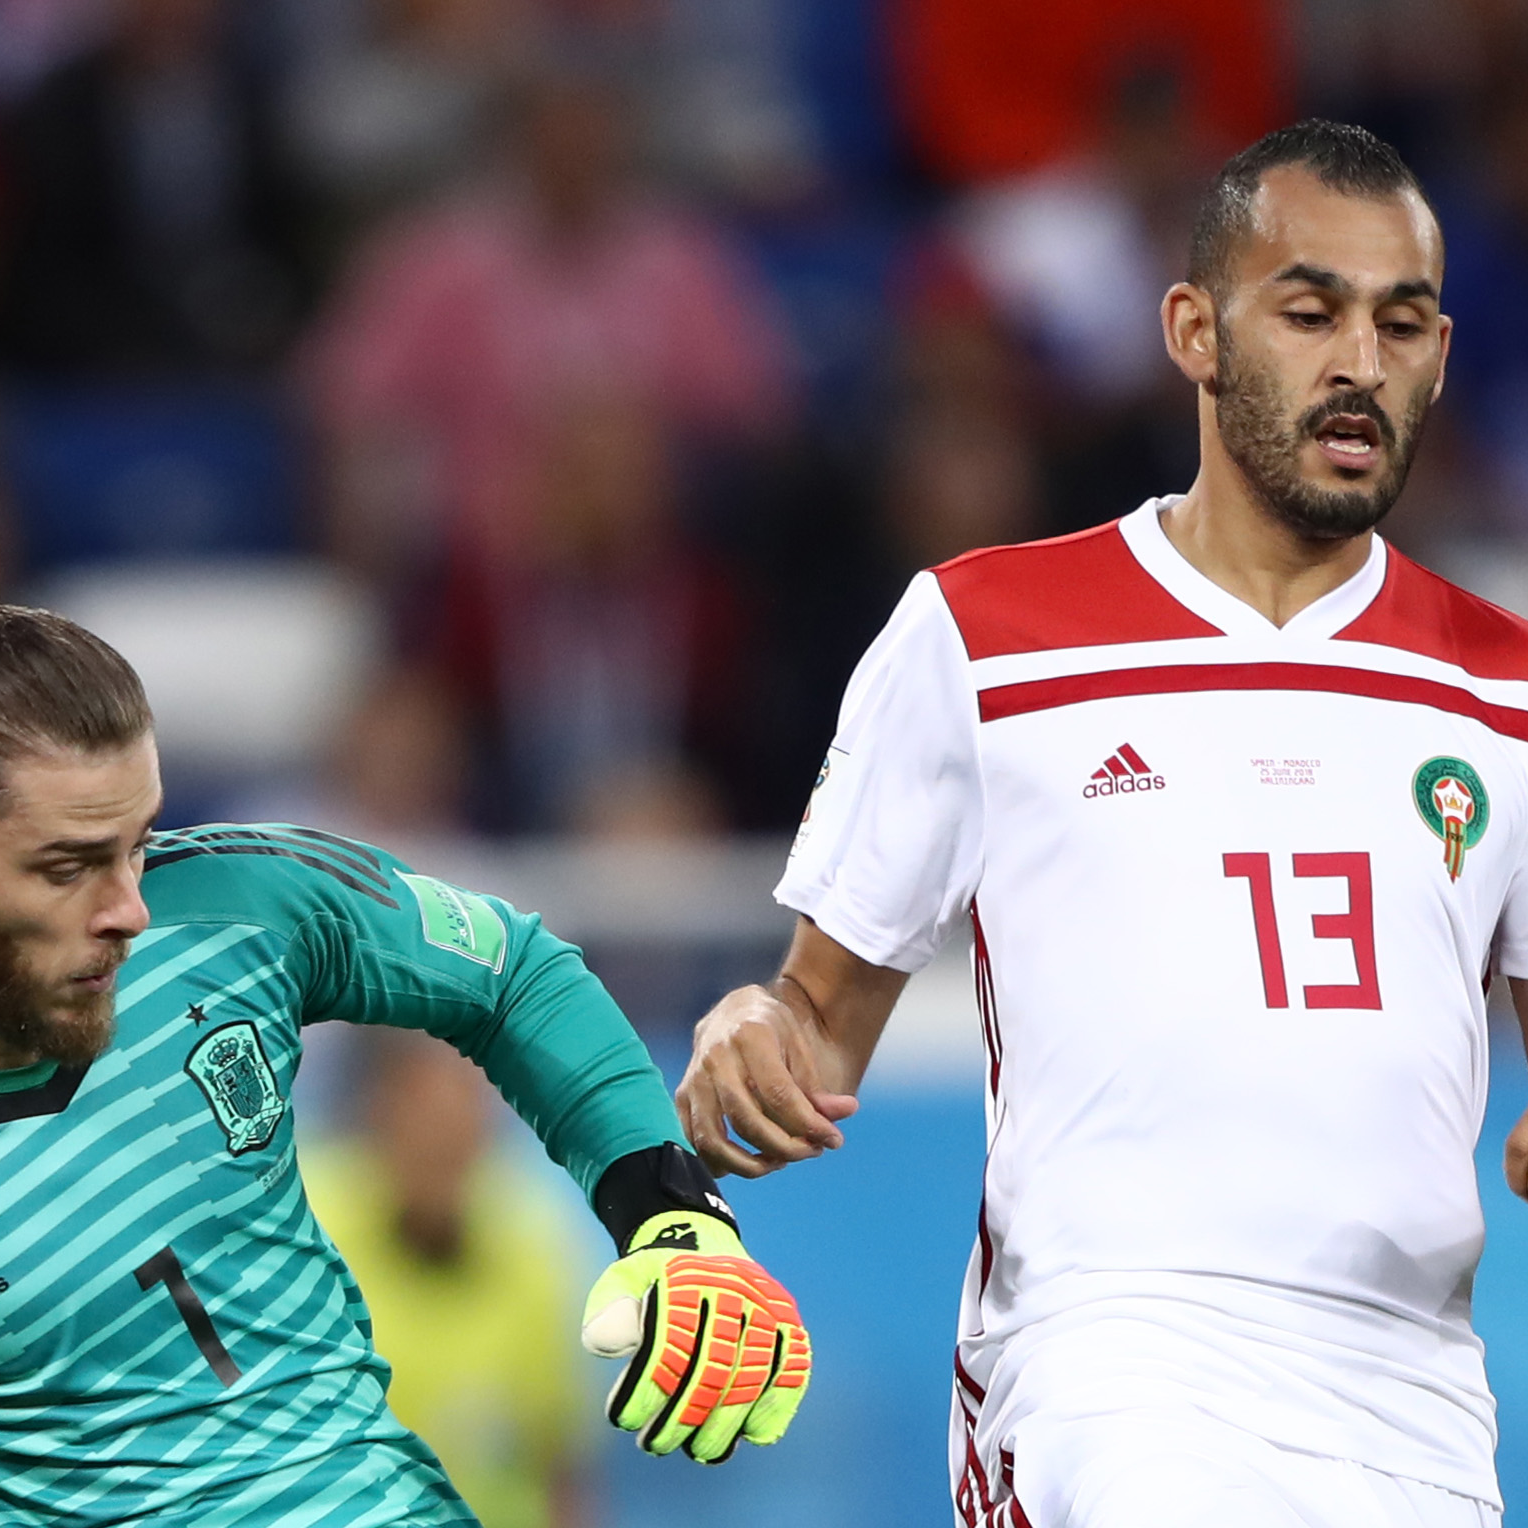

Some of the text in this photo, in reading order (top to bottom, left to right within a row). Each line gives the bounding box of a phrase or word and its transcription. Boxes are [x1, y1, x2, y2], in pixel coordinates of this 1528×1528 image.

[1083, 774, 1166, 799] adidas
[1221, 851, 1383, 1011] 13
[133, 1245, 243, 1388] 1
